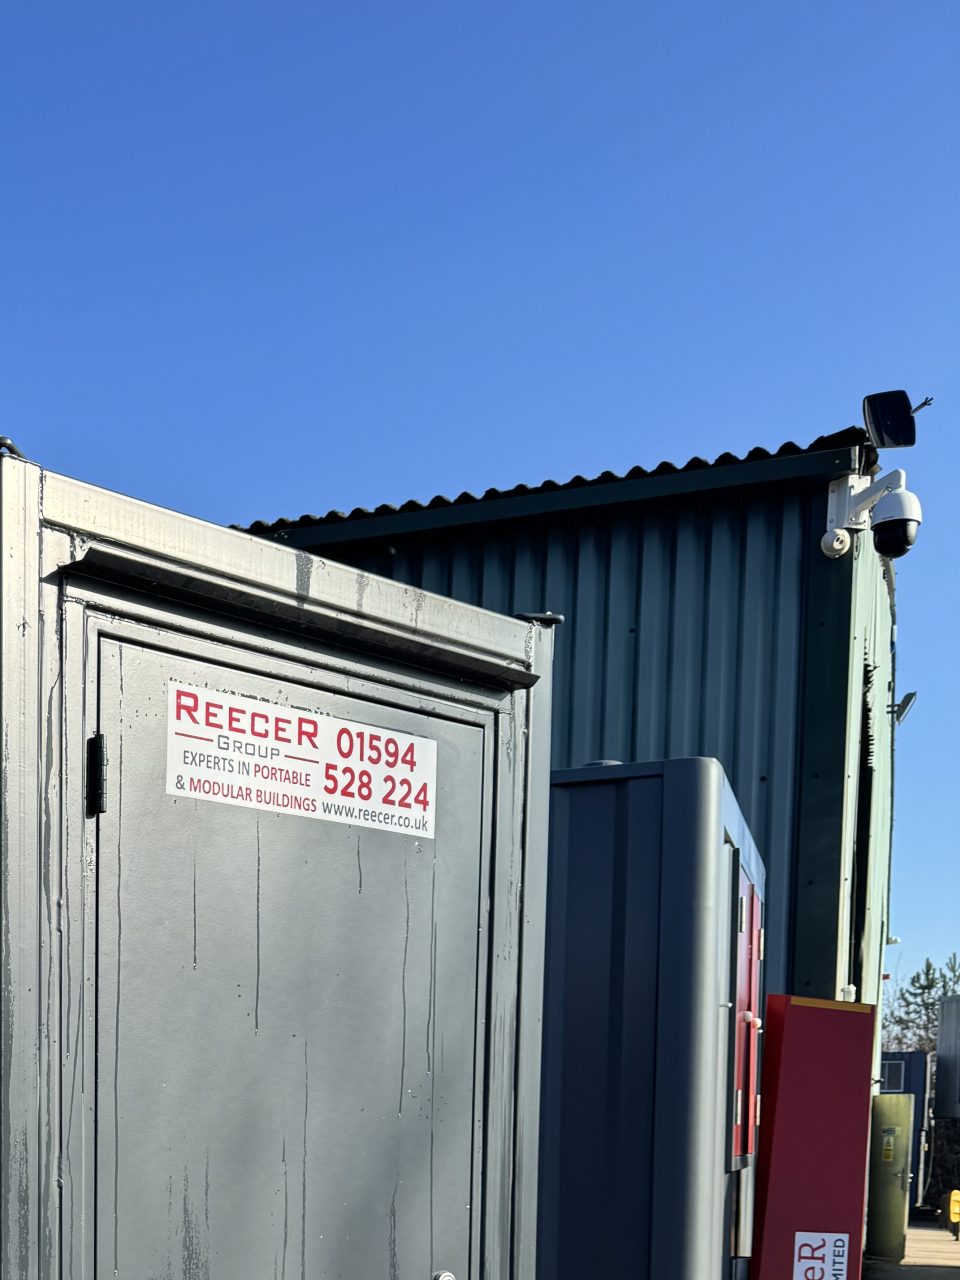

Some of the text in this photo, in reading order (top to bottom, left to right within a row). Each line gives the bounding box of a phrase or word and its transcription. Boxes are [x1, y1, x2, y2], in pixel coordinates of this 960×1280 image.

[175, 689, 320, 750] REECER
[216, 734, 280, 760] GROUP
[336, 727, 417, 772] 01594
[183, 750, 312, 788] EXPERTS IN PORTABLE
[323, 762, 430, 812] 528 224
[175, 774, 318, 813] & MODULAR BUILDINGS
[321, 800, 429, 832] www.reecer.co.uk
